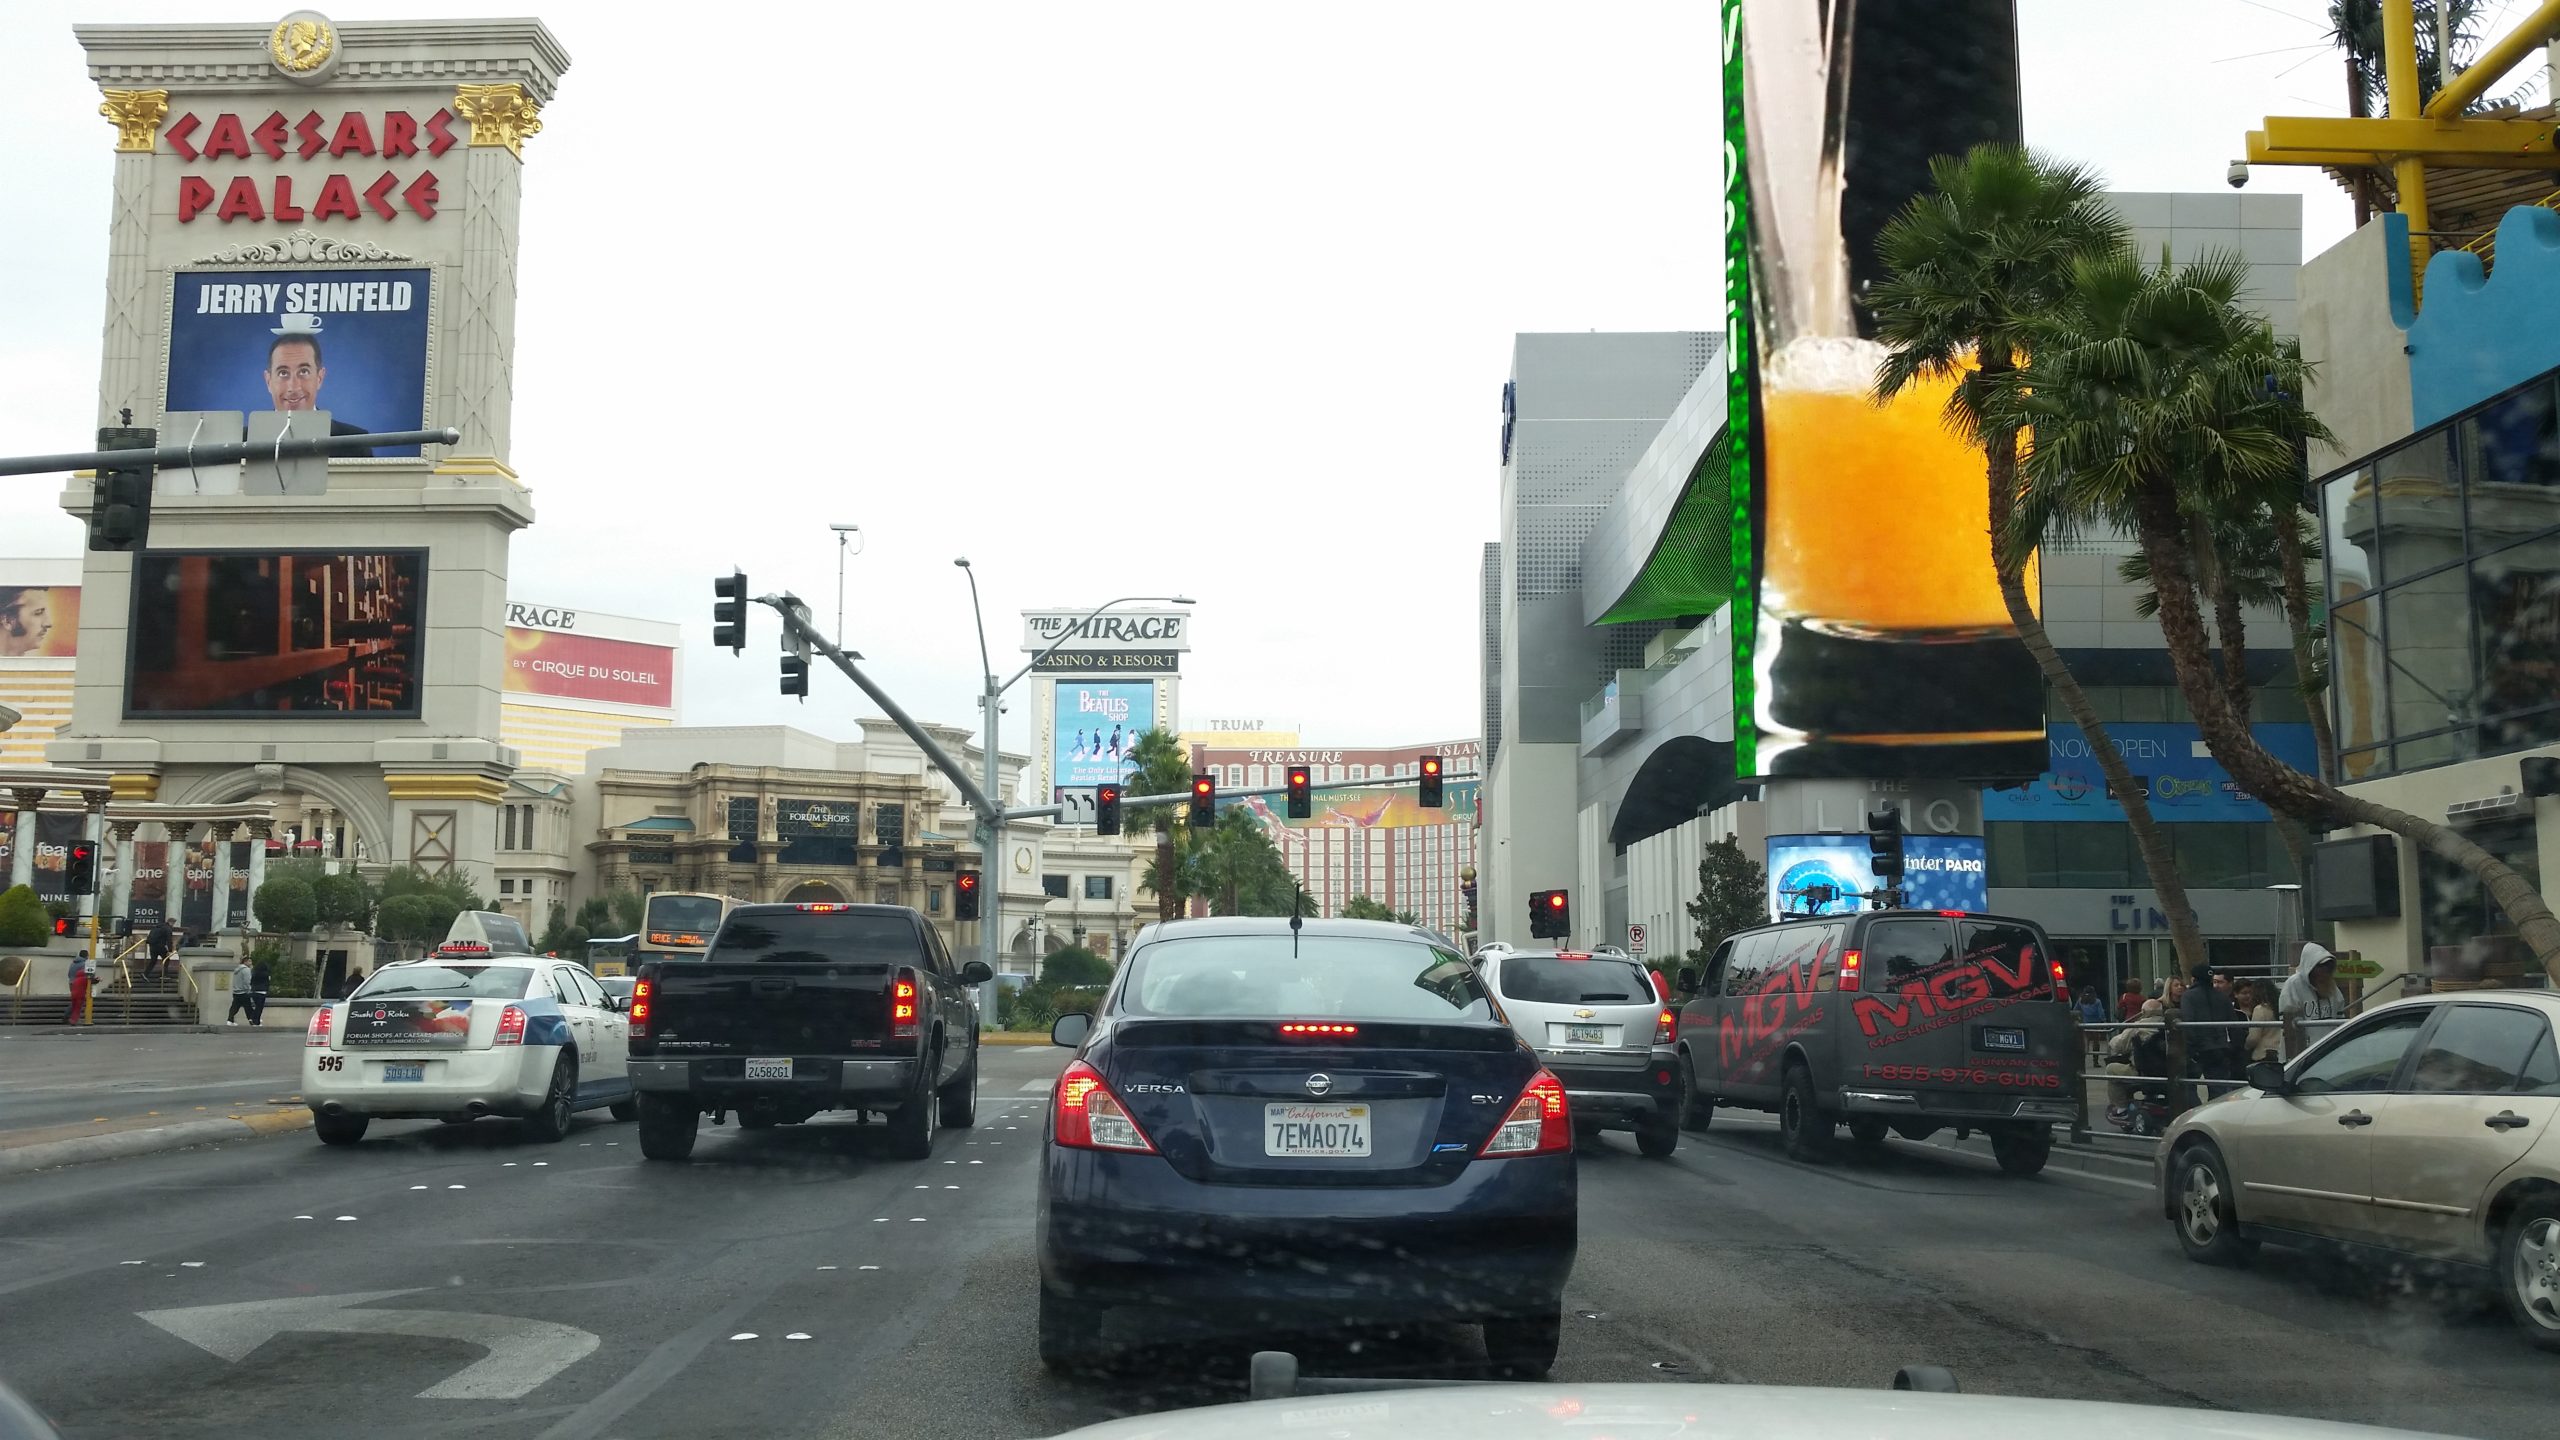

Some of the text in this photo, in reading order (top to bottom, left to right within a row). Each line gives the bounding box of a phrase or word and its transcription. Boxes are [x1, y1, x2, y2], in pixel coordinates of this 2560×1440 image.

[164, 107, 458, 163] CAESARS
[178, 169, 440, 223] PALACE
[197, 281, 412, 315] JERRY SEINFELD
[505, 602, 576, 630] RAGE
[1030, 617, 1182, 642] THE MIRAGE
[1036, 655, 1176, 667] CASINO & RESORT
[513, 659, 660, 686] BY CIRQUE DU SOLEIL
[1079, 690, 1129, 716] BEATLES
[1108, 712, 1129, 722] SHOP
[1210, 719, 1265, 731] TRUMP
[1249, 741, 1481, 764] TREASURE ISLAN
[2111, 738, 2167, 758] OPEN
[1869, 779, 1910, 793] THE
[2221, 782, 2240, 791] PURPL
[1328, 794, 1361, 802] MUST-SEE
[813, 805, 827, 813] THE
[789, 812, 850, 823] FORUM SHOPS
[1452, 813, 1474, 822] CIRQU
[36, 841, 68, 857] fea
[1904, 854, 1983, 872] inter PARQ
[135, 868, 163, 879] one
[186, 867, 213, 881] epic
[230, 866, 250, 879] feas
[40, 893, 70, 902] NINE
[134, 908, 160, 916] 500+
[453, 940, 477, 949] TAXI
[650, 933, 672, 944] DEUCE
[1852, 944, 2037, 1037] MGV
[1720, 934, 1836, 1071] MGV
[350, 1009, 410, 1019] Sushi Roku
[1867, 982, 2052, 1050] MACHINEGUNS VEGAS
[851, 1039, 881, 1048] GMC
[1999, 1033, 2019, 1045] MGV1
[318, 1055, 344, 1072] 595
[1969, 1057, 2060, 1068] GUNVAN.COM
[748, 1066, 790, 1079] 24582G1
[1862, 1063, 2061, 1089] 1-855-976-GUNS
[1124, 1084, 1186, 1094] VERSA
[1471, 1094, 1503, 1104] SV
[1270, 1106, 1350, 1123] MAR California
[1272, 1123, 1364, 1149] 7EMA074
